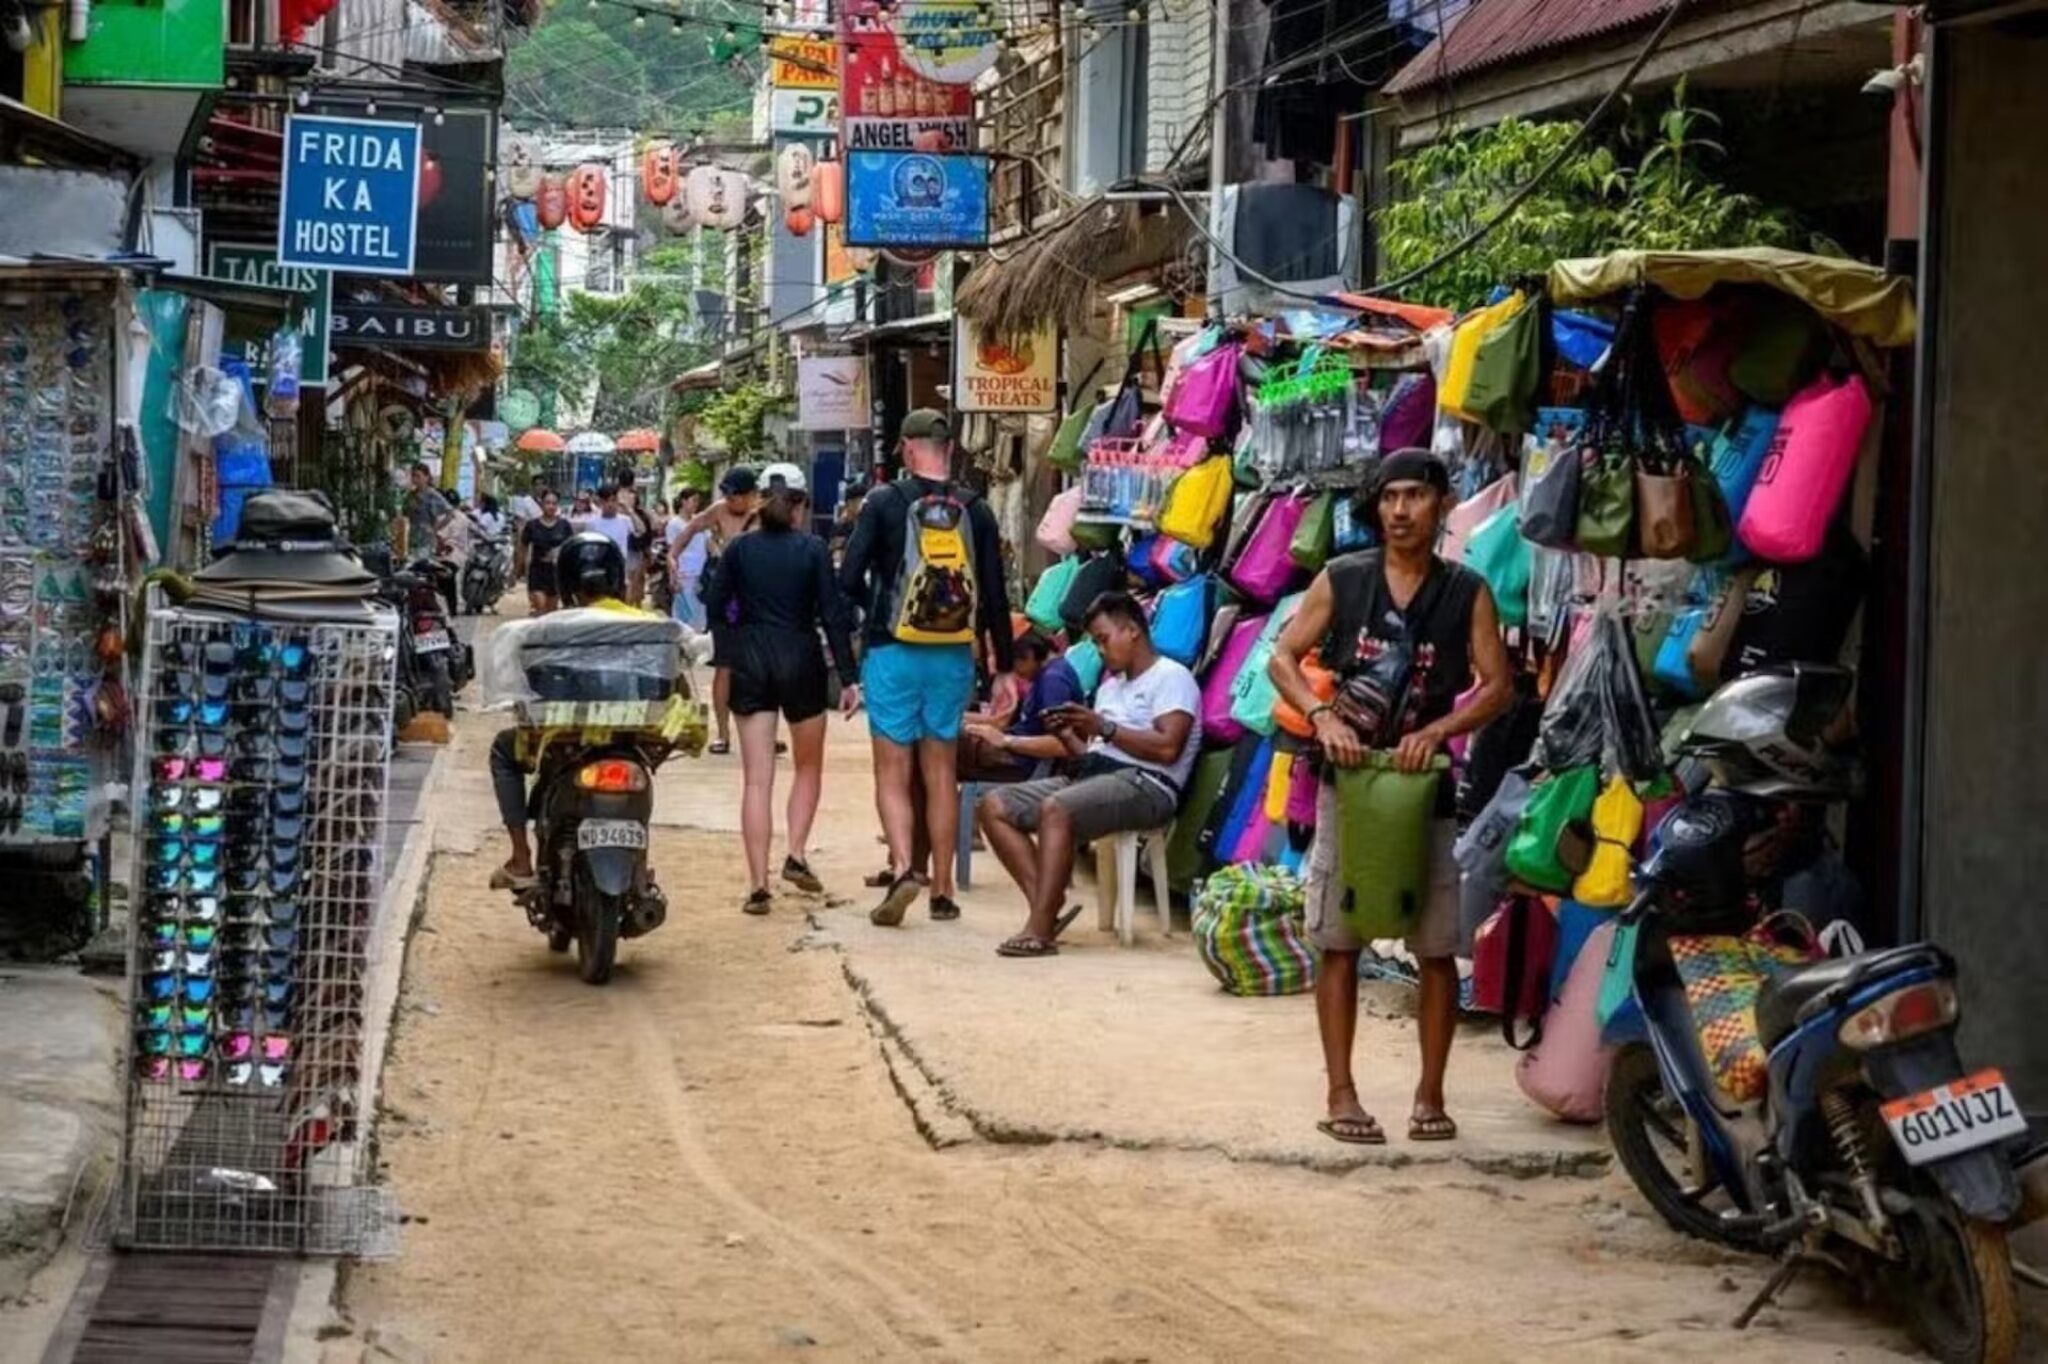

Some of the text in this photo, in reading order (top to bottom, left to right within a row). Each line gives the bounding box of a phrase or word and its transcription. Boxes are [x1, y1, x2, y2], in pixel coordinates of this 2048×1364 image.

[299, 131, 404, 171] FRIDA
[852, 122, 914, 148] ANGEL
[324, 176, 373, 212] KA
[295, 219, 399, 258] HOSTEL
[223, 257, 318, 292] TACOS
[329, 314, 471, 339] BAIBU
[965, 377, 1053, 392] TROPICAL
[976, 391, 1042, 406] TREATS
[1902, 1086, 2014, 1147] 601VJZ
